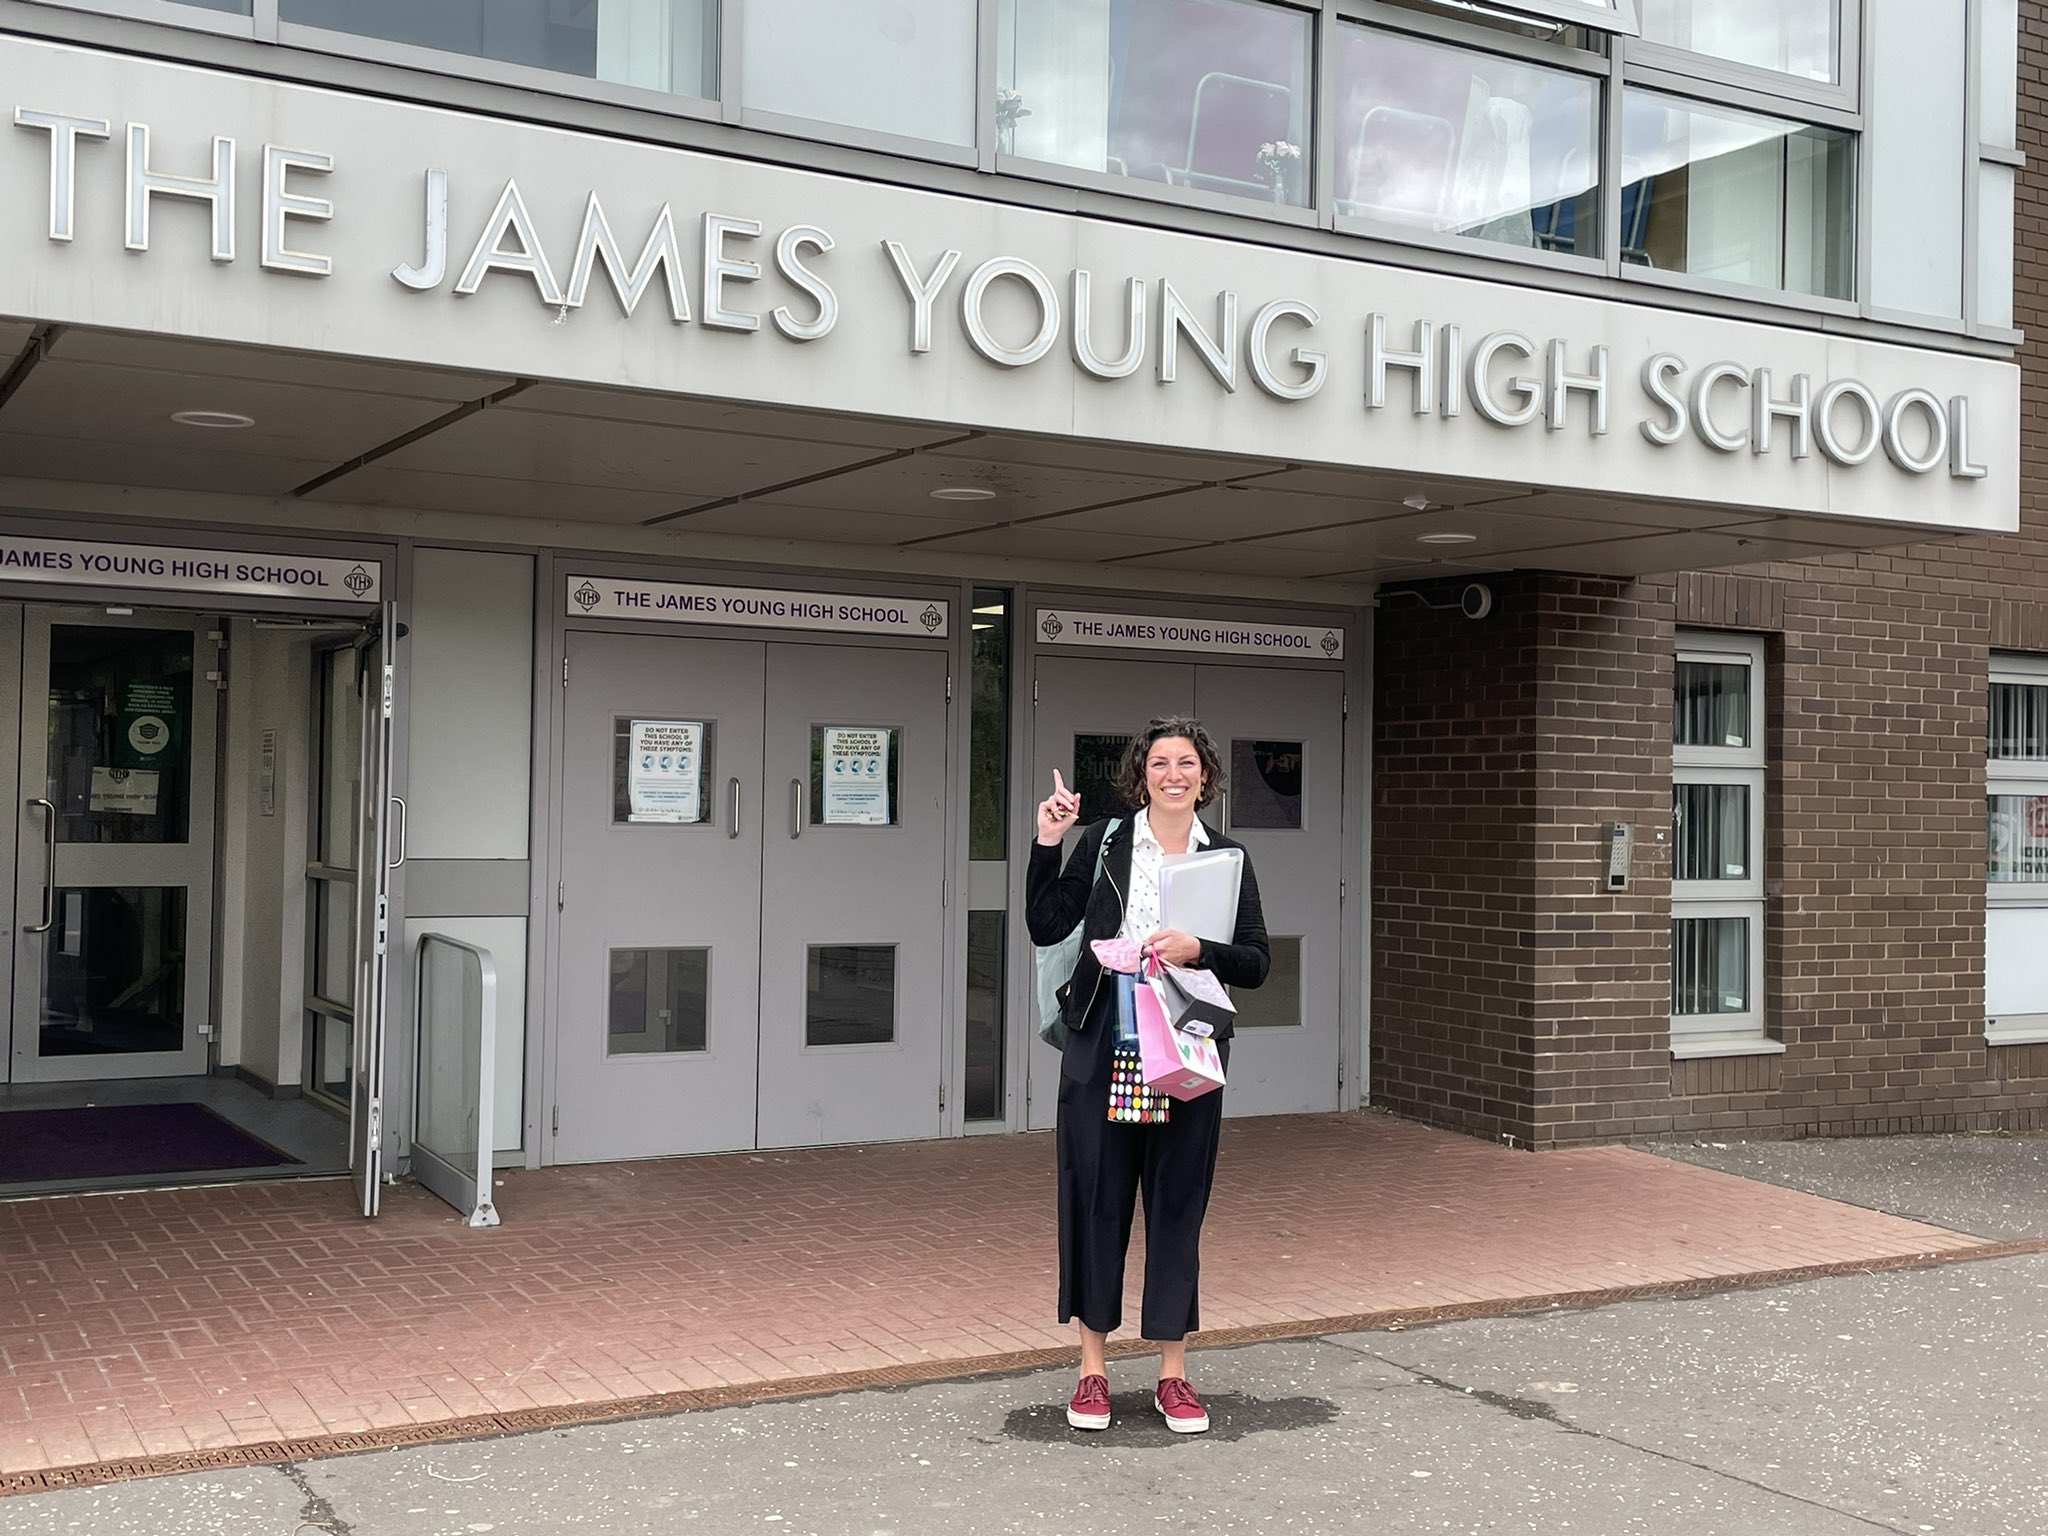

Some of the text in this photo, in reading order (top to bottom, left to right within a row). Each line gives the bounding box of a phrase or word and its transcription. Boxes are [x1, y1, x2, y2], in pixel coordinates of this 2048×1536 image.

[14, 104, 1988, 479] THE JAMES YOUNG HIGH SCHOOL
[80, 554, 164, 575] YOUNG
[172, 560, 229, 580] HIGH
[236, 565, 329, 586] SCHOOL
[613, 591, 909, 624] THE JAMES YOUNG HIGH SCHOOL
[1073, 621, 1312, 649] THE JAMES YOUNG HIGH SCHOOL
